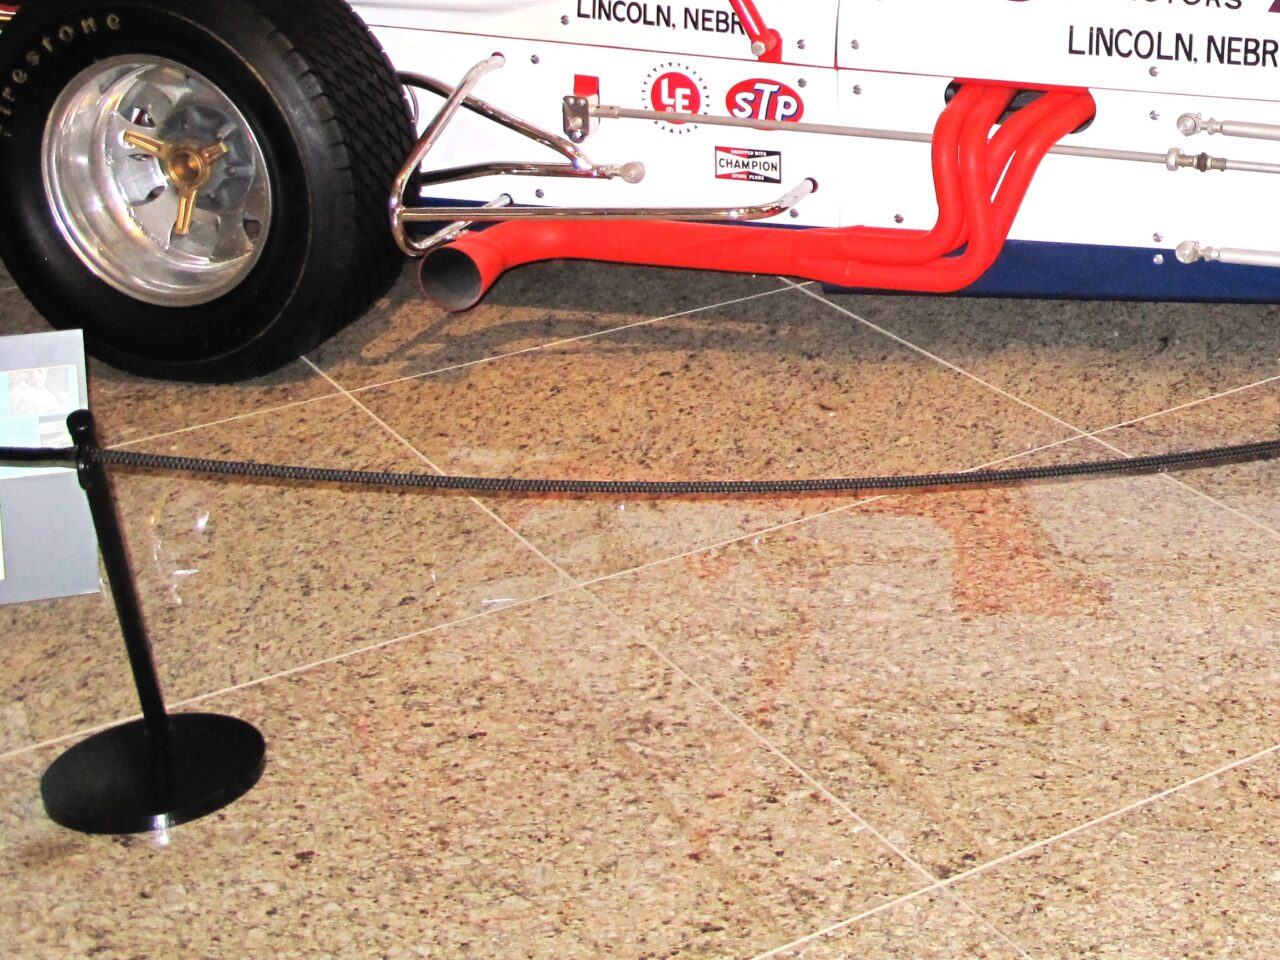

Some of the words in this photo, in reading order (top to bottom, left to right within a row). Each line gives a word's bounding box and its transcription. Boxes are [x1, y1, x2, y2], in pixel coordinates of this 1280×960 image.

[1066, 24, 1199, 66] LINCOLN,
[0, 13, 120, 139] irestone
[732, 83, 799, 121] STP
[719, 158, 778, 172] CHAMPION
